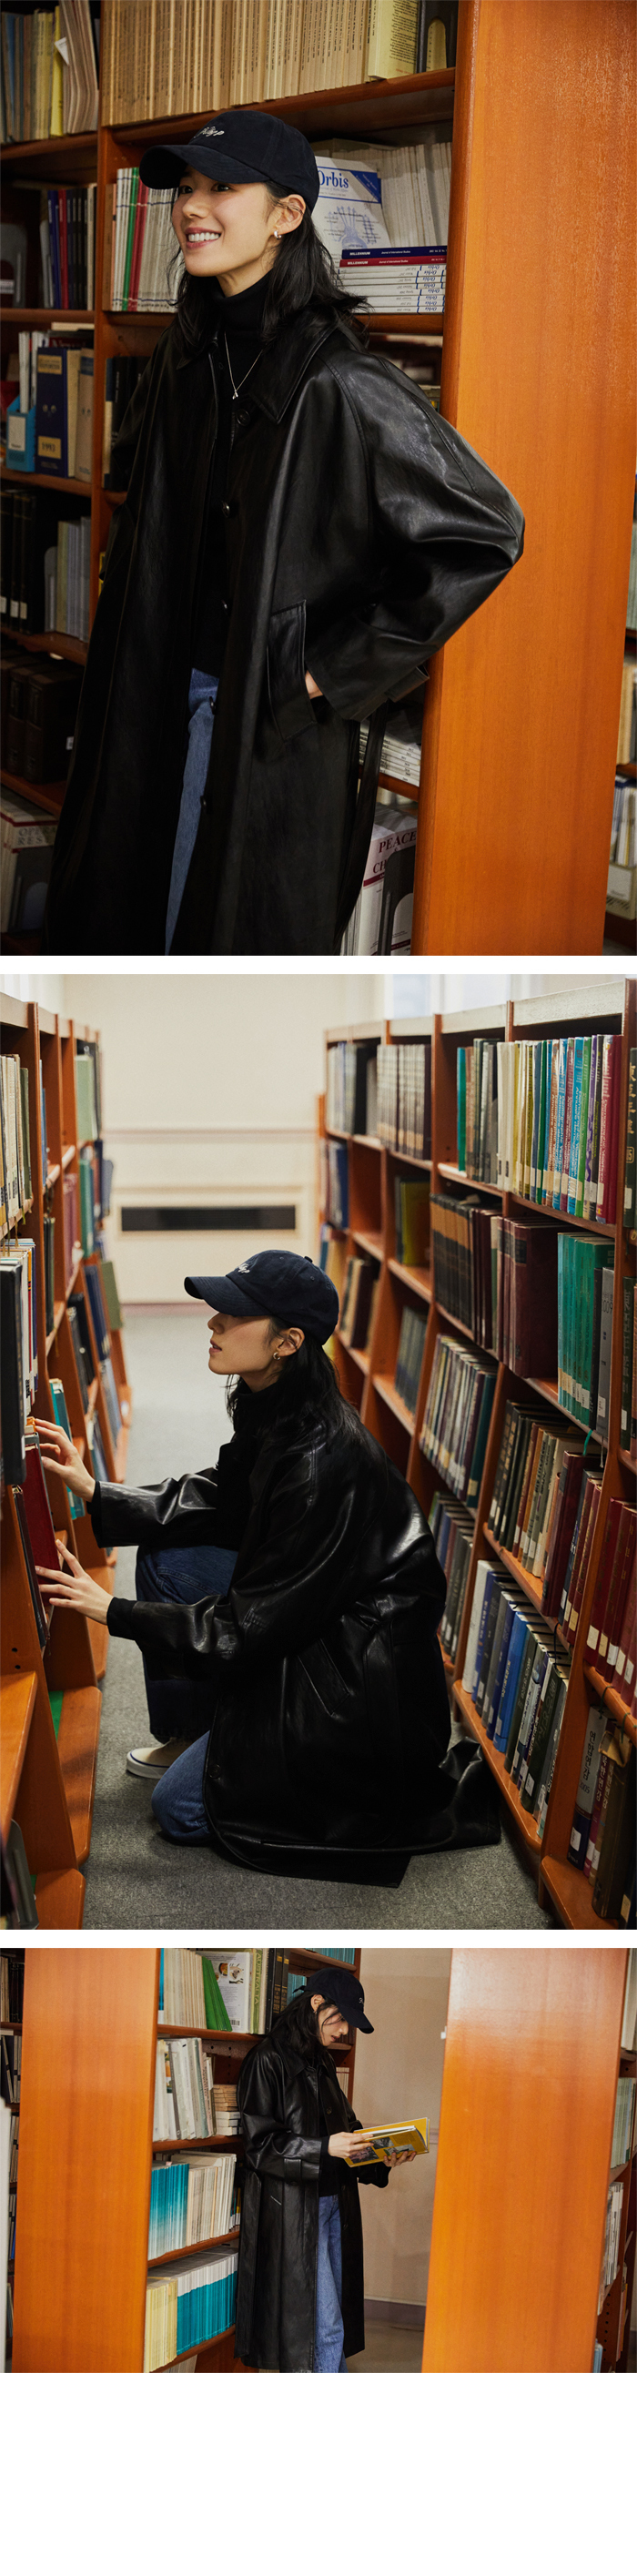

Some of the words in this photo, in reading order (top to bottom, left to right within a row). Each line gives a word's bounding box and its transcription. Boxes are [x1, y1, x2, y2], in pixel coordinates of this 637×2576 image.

[318, 170, 349, 189] Orbis
[379, 830, 417, 854] PEACE
[583, 1731, 596, 1781] 연합연감
[579, 1782, 590, 1794] 2005
